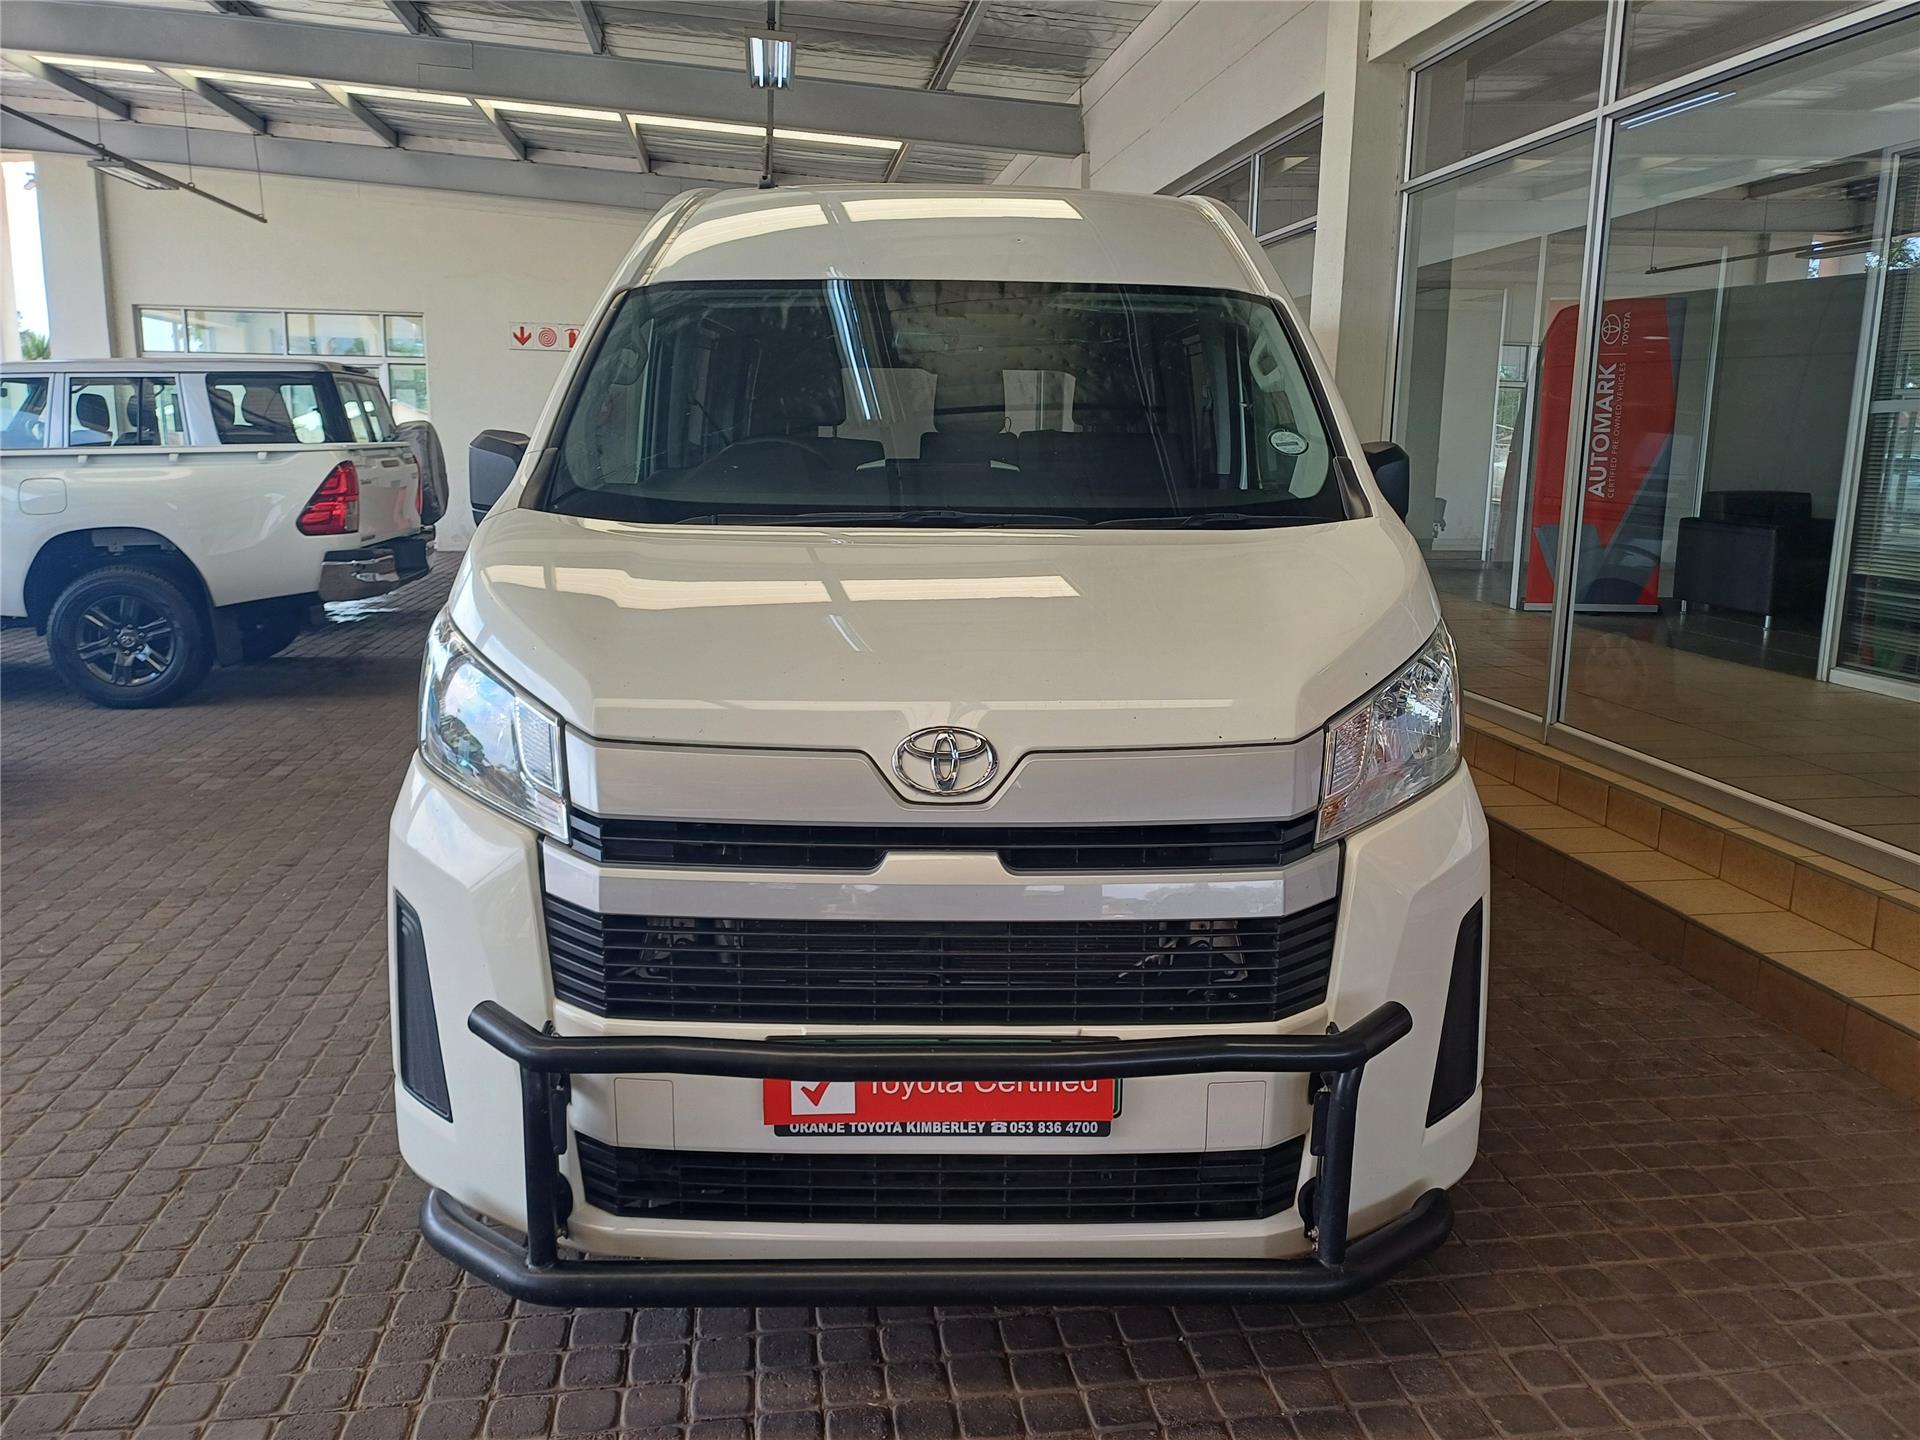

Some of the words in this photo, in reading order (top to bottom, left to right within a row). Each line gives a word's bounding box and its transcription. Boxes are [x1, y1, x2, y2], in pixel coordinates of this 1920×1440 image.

[1621, 311, 1632, 346] TOYOTA
[1587, 362, 1617, 498] AUTOMARK
[1607, 457, 1617, 499] CERTIFIED
[1616, 362, 1626, 401] VEHICLES
[789, 1122, 845, 1134] ORANJE
[850, 1122, 903, 1134] TOYOTA
[906, 1121, 986, 1134] KIMBERLEY
[1009, 1121, 1034, 1134] 053
[1037, 1121, 1062, 1134] 836
[1065, 1121, 1098, 1134] 4700
